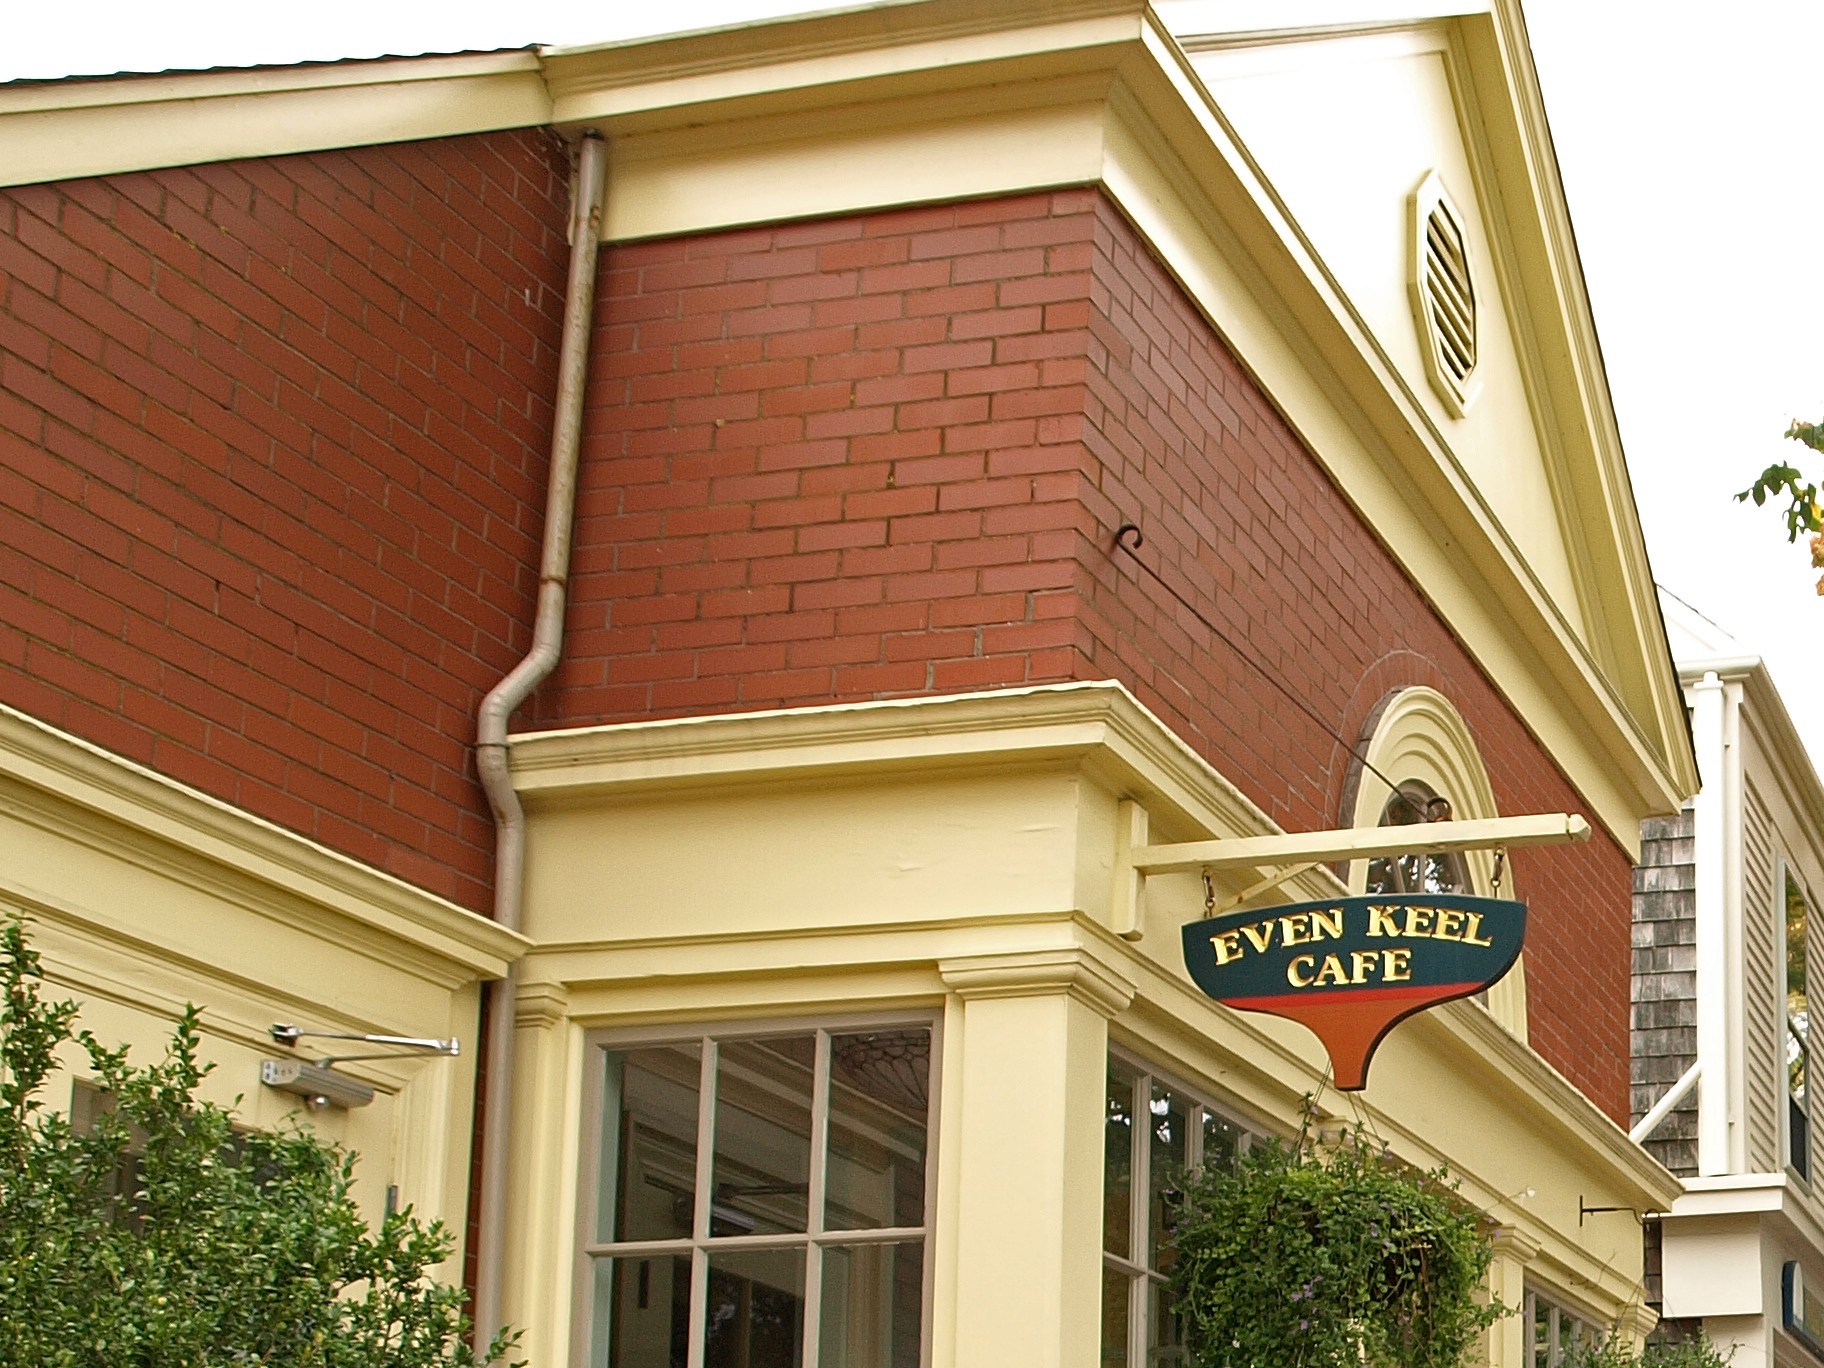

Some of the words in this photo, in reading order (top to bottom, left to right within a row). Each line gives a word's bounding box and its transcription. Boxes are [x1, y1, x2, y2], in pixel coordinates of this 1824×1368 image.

[1210, 907, 1344, 965] EVEN
[1367, 905, 1493, 947] KEEL
[1287, 948, 1412, 987] CAFE
